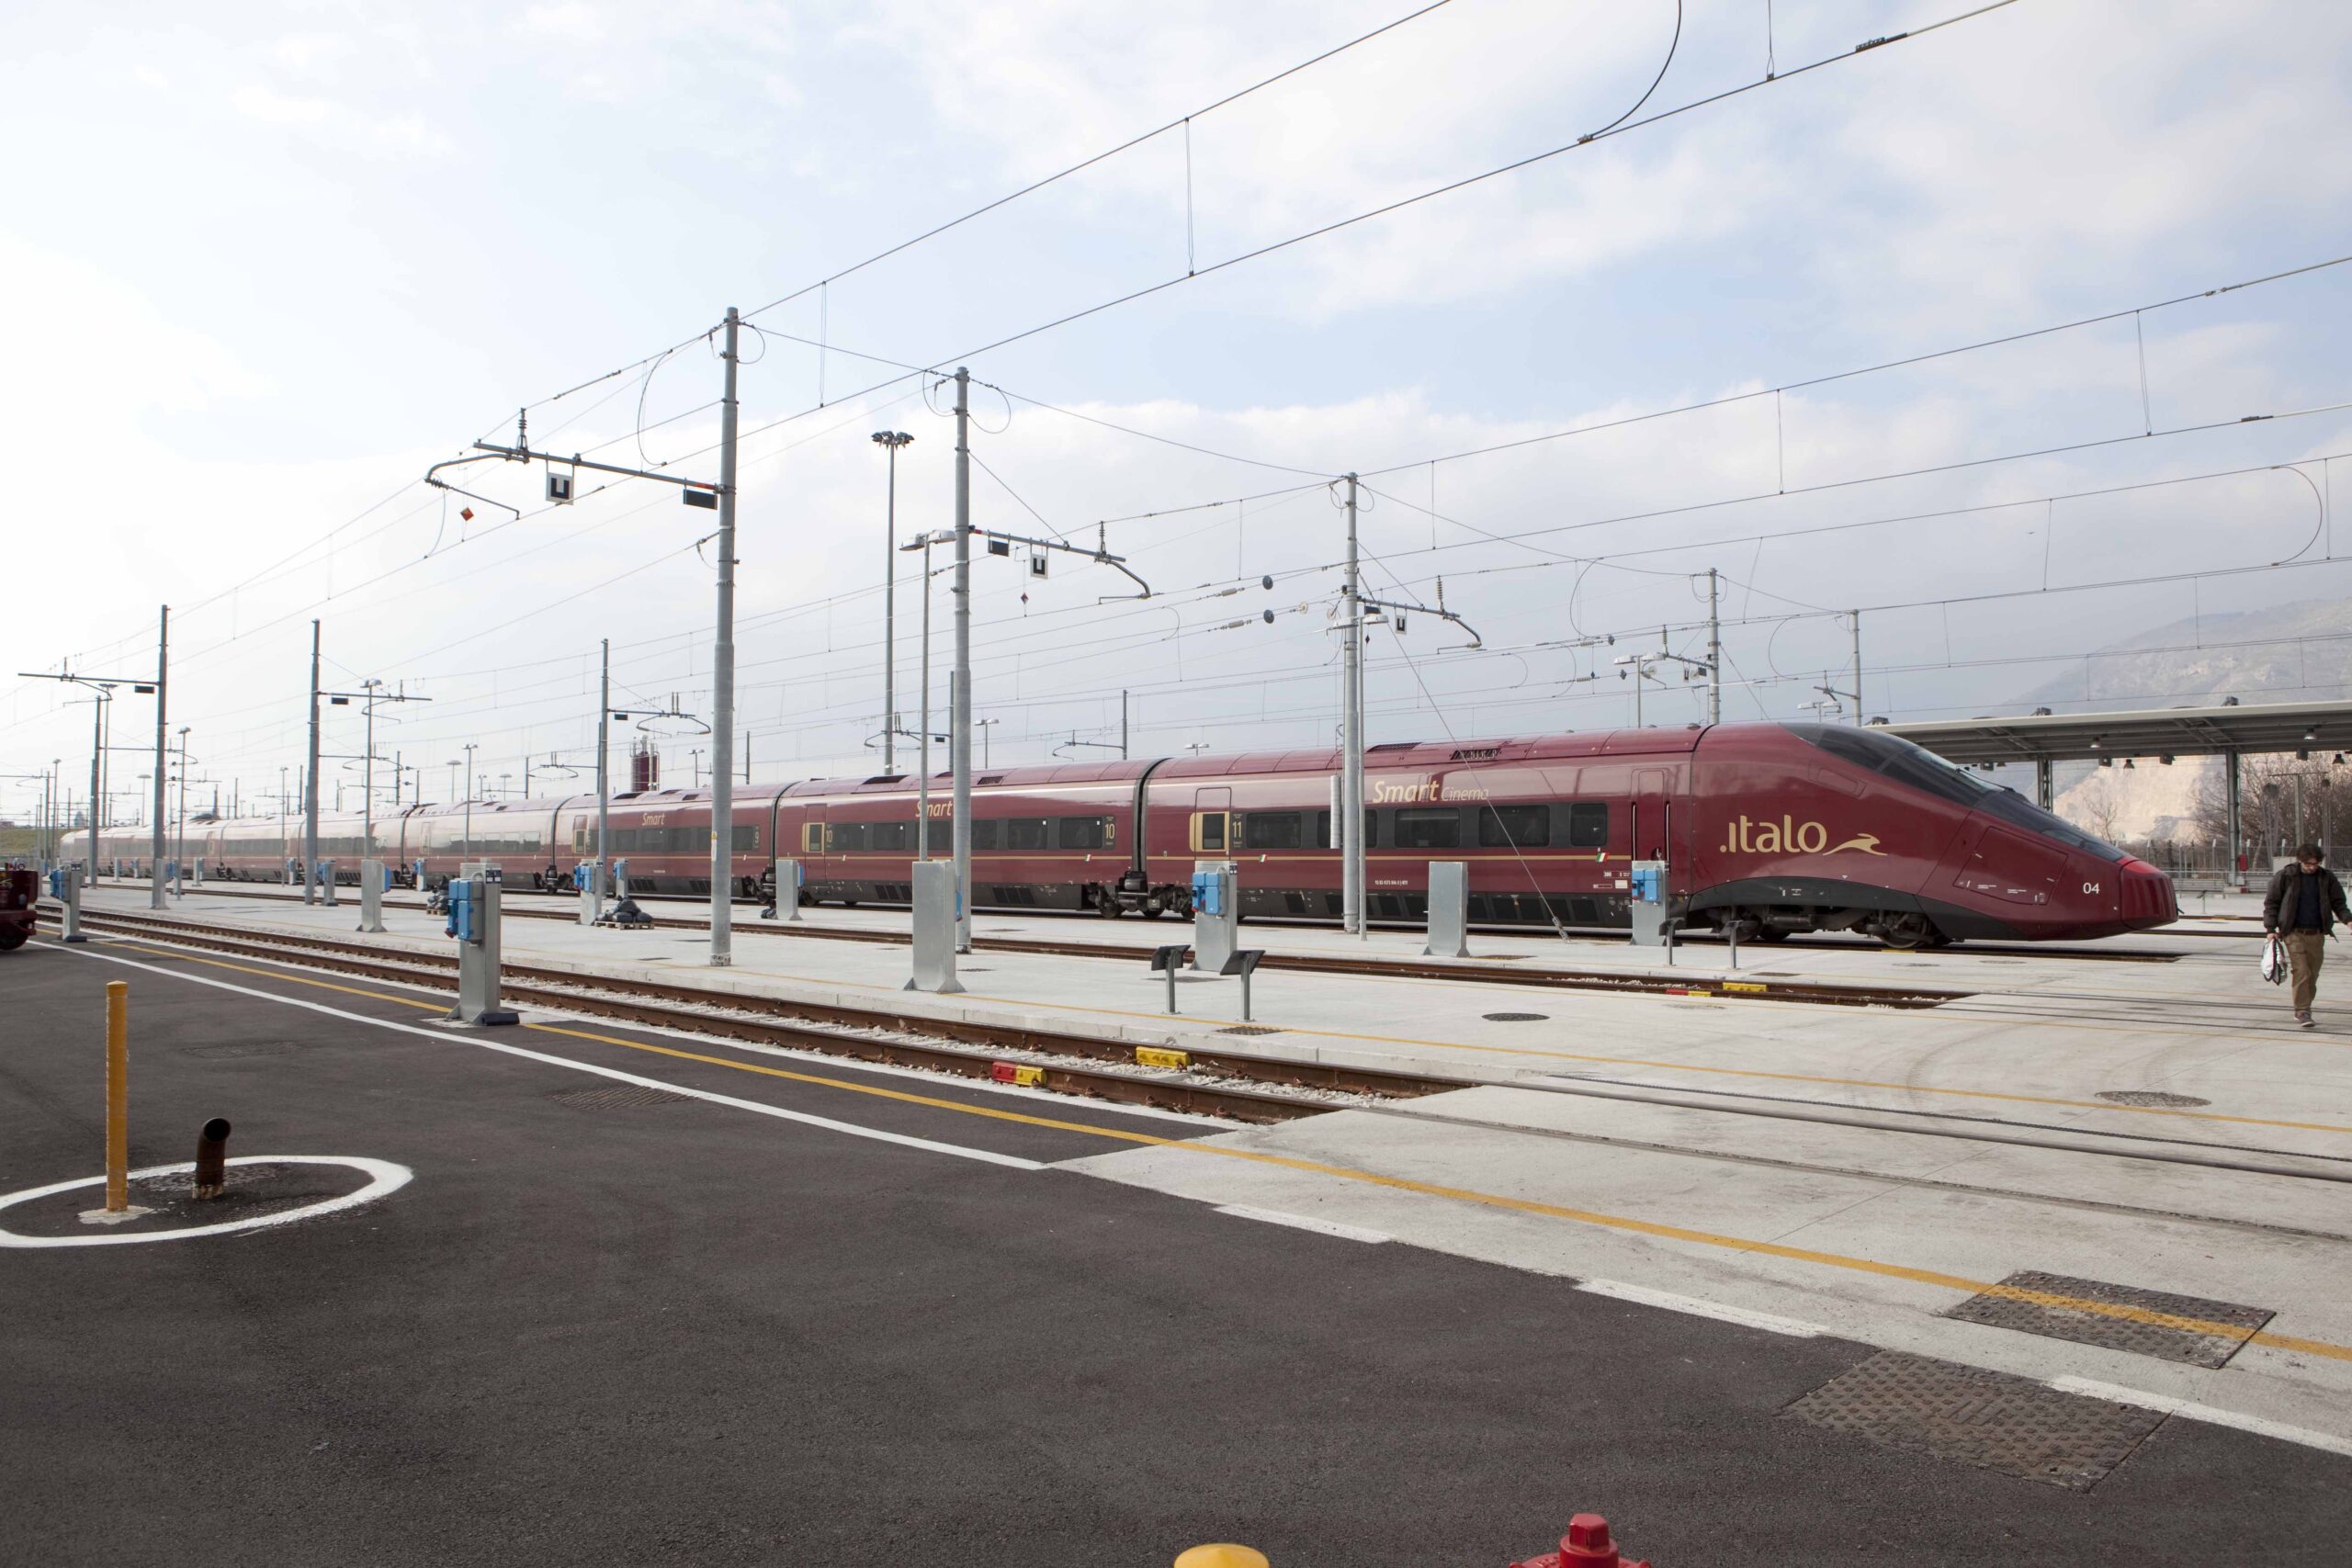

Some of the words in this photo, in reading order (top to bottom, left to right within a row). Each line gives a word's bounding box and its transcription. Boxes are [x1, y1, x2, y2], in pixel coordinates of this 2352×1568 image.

[1372, 780, 1440, 803] Smart
[1441, 786, 1488, 801] Cinema
[641, 812, 666, 826] Smart
[826, 829, 833, 843] 10
[1104, 823, 1115, 840] 10
[1232, 821, 1242, 839] 11
[2083, 882, 2099, 895] 04
